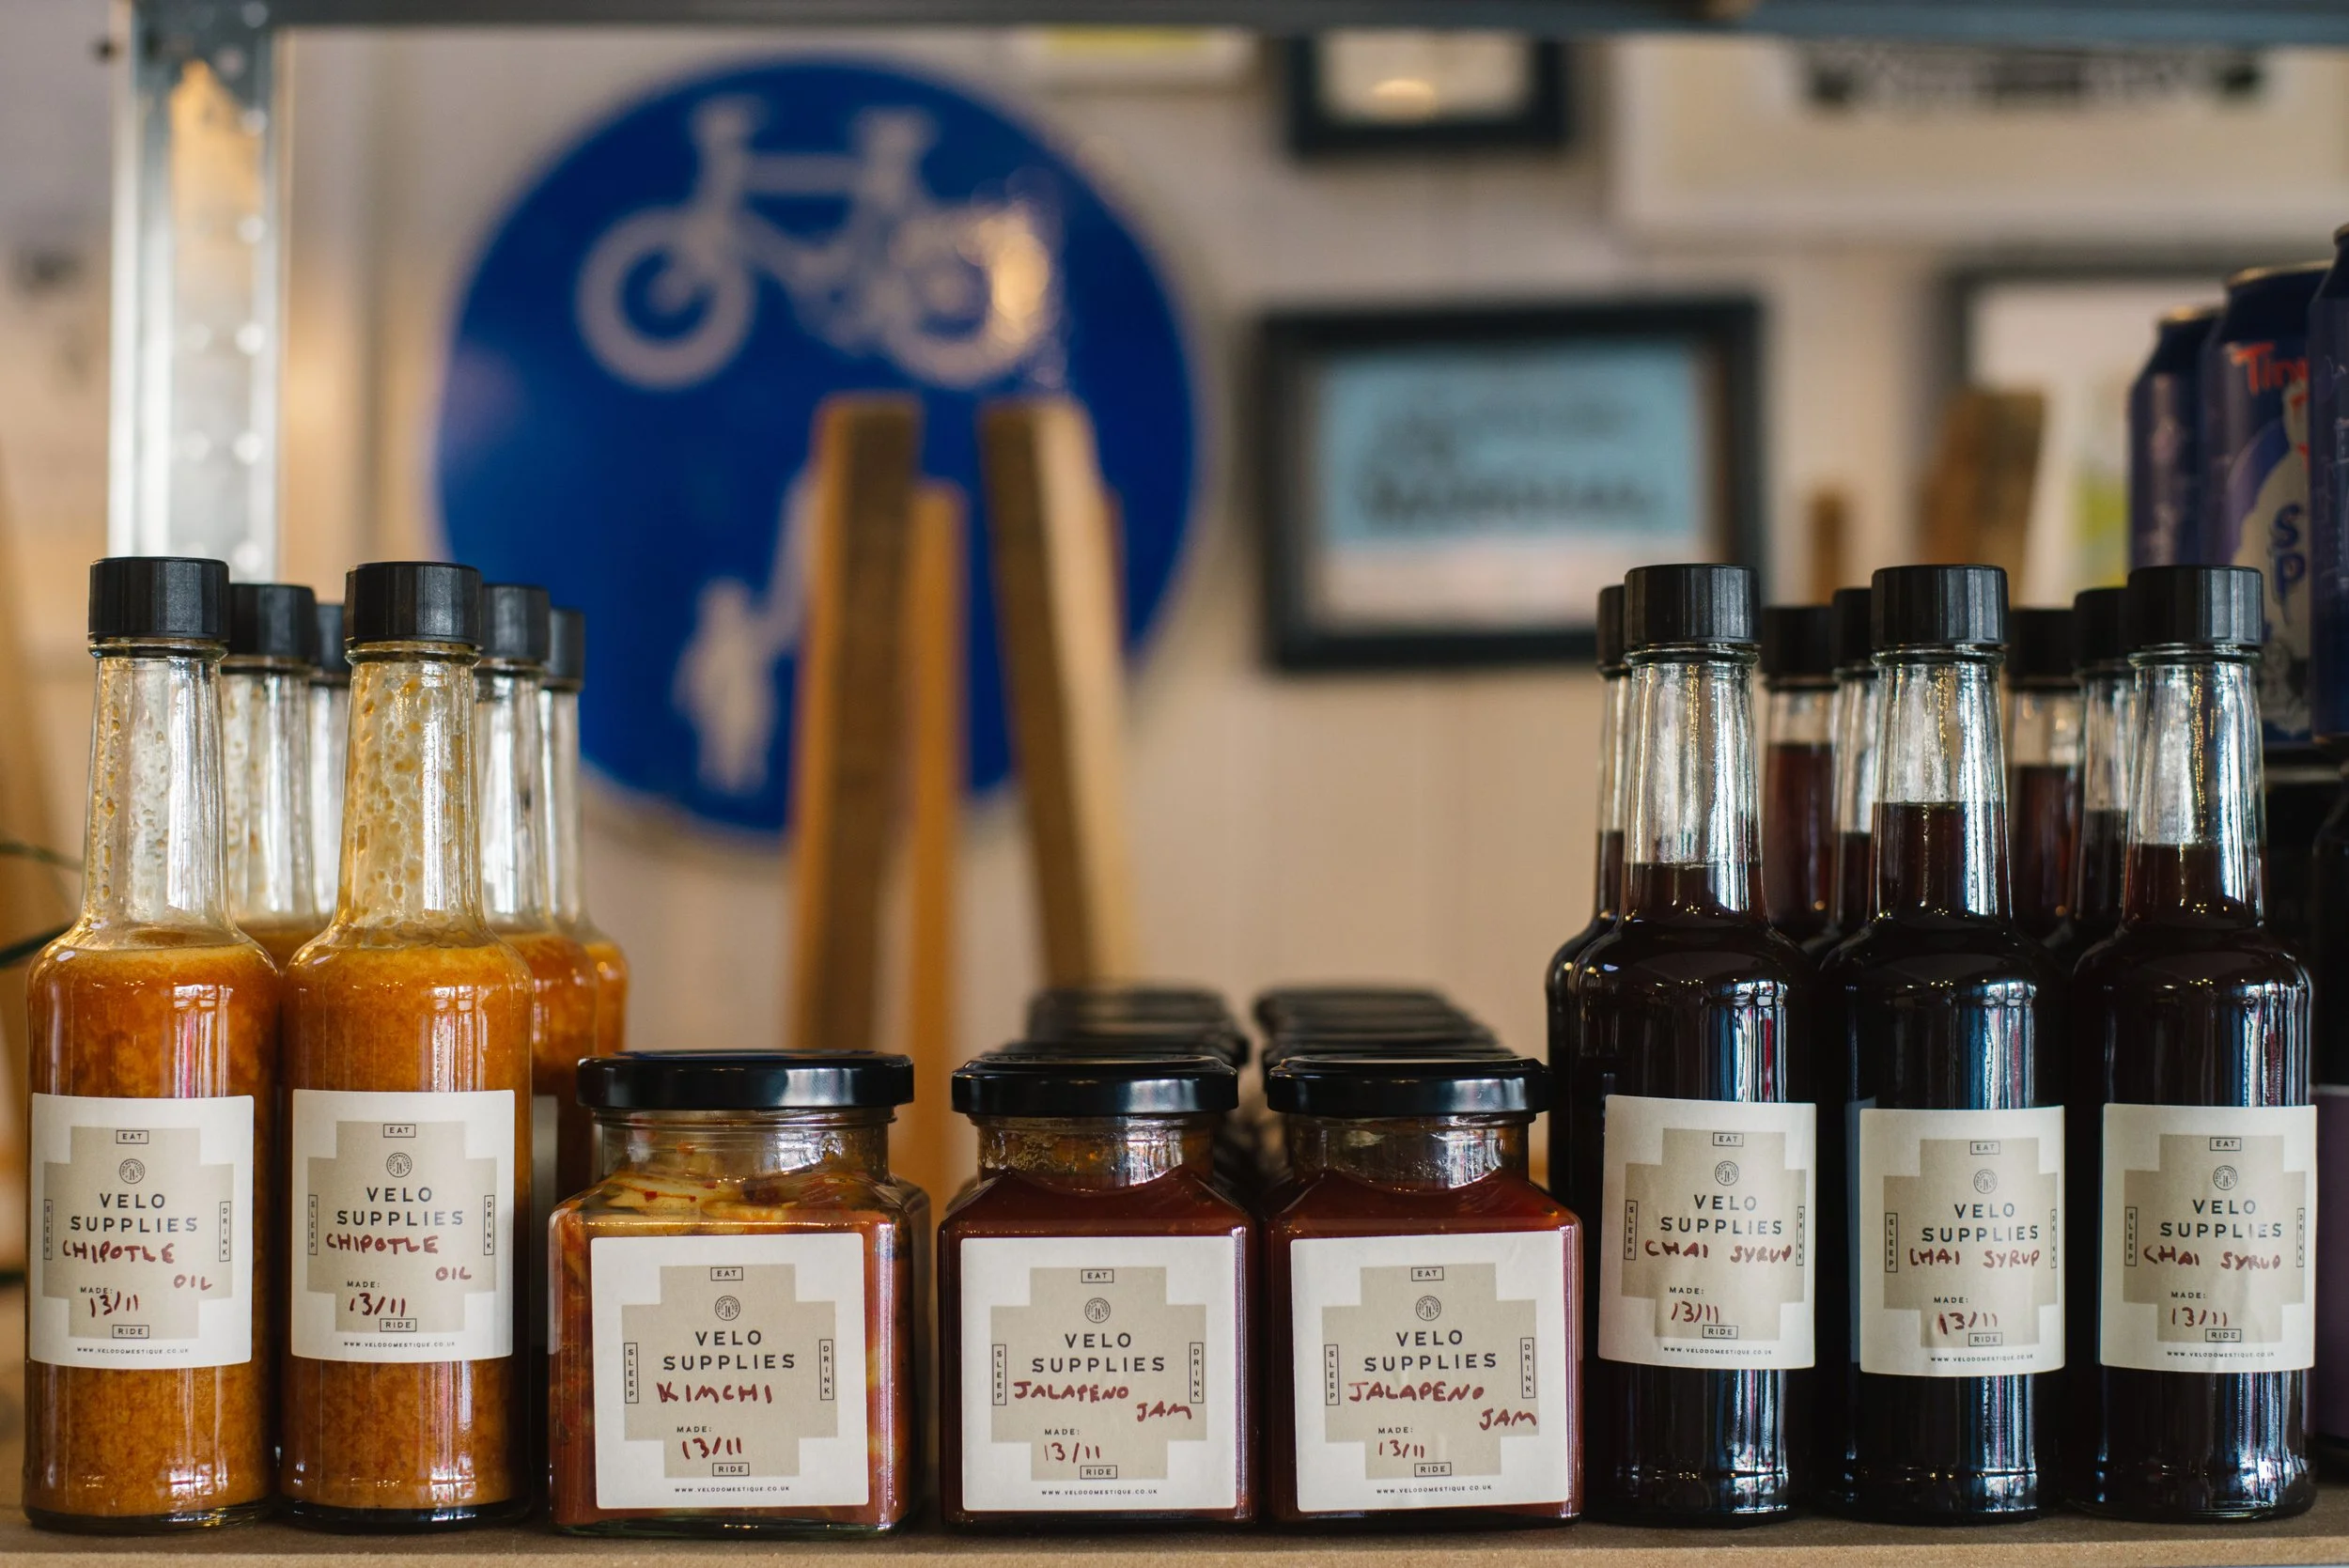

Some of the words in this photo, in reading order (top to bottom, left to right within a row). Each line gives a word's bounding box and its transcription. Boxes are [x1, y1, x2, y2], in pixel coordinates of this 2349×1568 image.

[121, 1132, 143, 1141] EAT
[100, 1193, 165, 1208] VELO
[366, 1188, 432, 1203] VELO
[1694, 1194, 1757, 1211] VELO
[1954, 1203, 2015, 1218] VELO
[2193, 1199, 2256, 1215] VELO
[70, 1216, 197, 1232] SUPPLIES
[336, 1210, 464, 1226] SUPPLIES
[1660, 1217, 1781, 1235] SUPPLIES
[1921, 1225, 2038, 1243] SUPPLIES
[2159, 1222, 2282, 1238] SUPPLIES
[62, 1240, 175, 1264] CHIPOTLE
[326, 1233, 439, 1255] CHIPOTLE
[1644, 1239, 1708, 1258] CHAI
[1730, 1245, 1792, 1264] SYRUP
[1983, 1250, 2041, 1268] SYRUP
[2143, 1245, 2200, 1266] CHAI
[435, 1266, 472, 1281] OIL
[1086, 1271, 1108, 1280] EAT
[1417, 1269, 1438, 1278] EAT
[173, 1274, 212, 1291] OIL
[1668, 1286, 1704, 1295] MADE:
[90, 1291, 139, 1317] 13/11
[349, 1292, 406, 1317] 13/11
[1933, 1296, 1969, 1304] MADE:
[1671, 1300, 1719, 1324] 13/11
[2172, 1307, 2227, 1327] 13/11
[384, 1320, 412, 1328] RIDE
[1707, 1327, 1733, 1336] RIDE
[1938, 1312, 1998, 1335] 13/11
[695, 1330, 762, 1345] VELO
[1065, 1332, 1131, 1348] VELO
[1396, 1329, 1463, 1346] VELO
[1973, 1335, 1998, 1343] RIDE
[2210, 1331, 2236, 1340] RIDE
[663, 1354, 795, 1371] SUPPLIES
[1032, 1357, 1165, 1373] SUPPLIES
[1364, 1353, 1497, 1372] SUPPLIES
[657, 1381, 772, 1404] KIMCHI
[1013, 1381, 1129, 1403] JALAPENO
[1347, 1381, 1485, 1403] JALAPENO
[1137, 1401, 1192, 1421] JAM
[1479, 1408, 1537, 1430] JAM
[676, 1425, 712, 1434] MADE:
[1044, 1427, 1081, 1436] MADE:
[1377, 1426, 1413, 1435] MADE:
[682, 1437, 742, 1459] 13/11
[1044, 1442, 1100, 1463] 13/11
[1378, 1440, 1425, 1458] 13/11
[717, 1465, 744, 1473] RIDE
[1085, 1467, 1112, 1476] RIDE
[1419, 1465, 1446, 1473] RIDE
[1376, 1483, 1492, 1495] WWW.VELODOMESTIQUE.CO.UK
